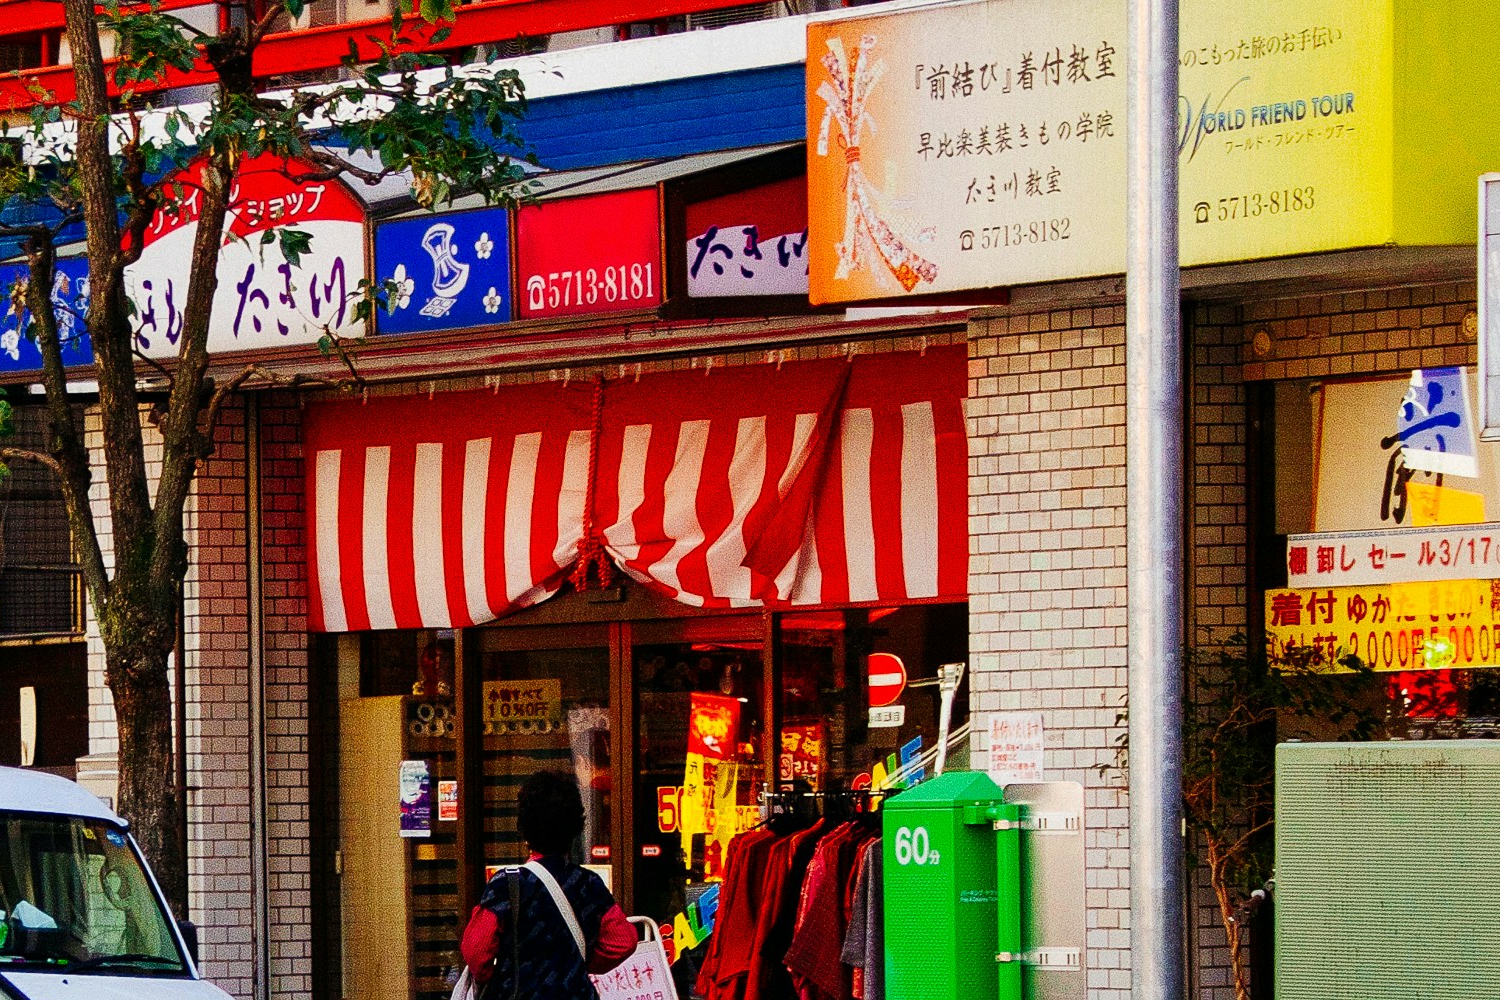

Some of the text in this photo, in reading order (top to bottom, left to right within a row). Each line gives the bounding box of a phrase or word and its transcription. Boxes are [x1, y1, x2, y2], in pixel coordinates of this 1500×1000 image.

[1178, 26, 1342, 68] のこもった旅のお手伝い
[915, 41, 1116, 101] 『前結び』着付教室
[1251, 99, 1307, 127] FRIEND
[1312, 92, 1355, 119] TOUR
[1218, 186, 1315, 222] 5713-8183
[981, 217, 1071, 250] 5713-8182
[658, 883, 720, 967] SALE
